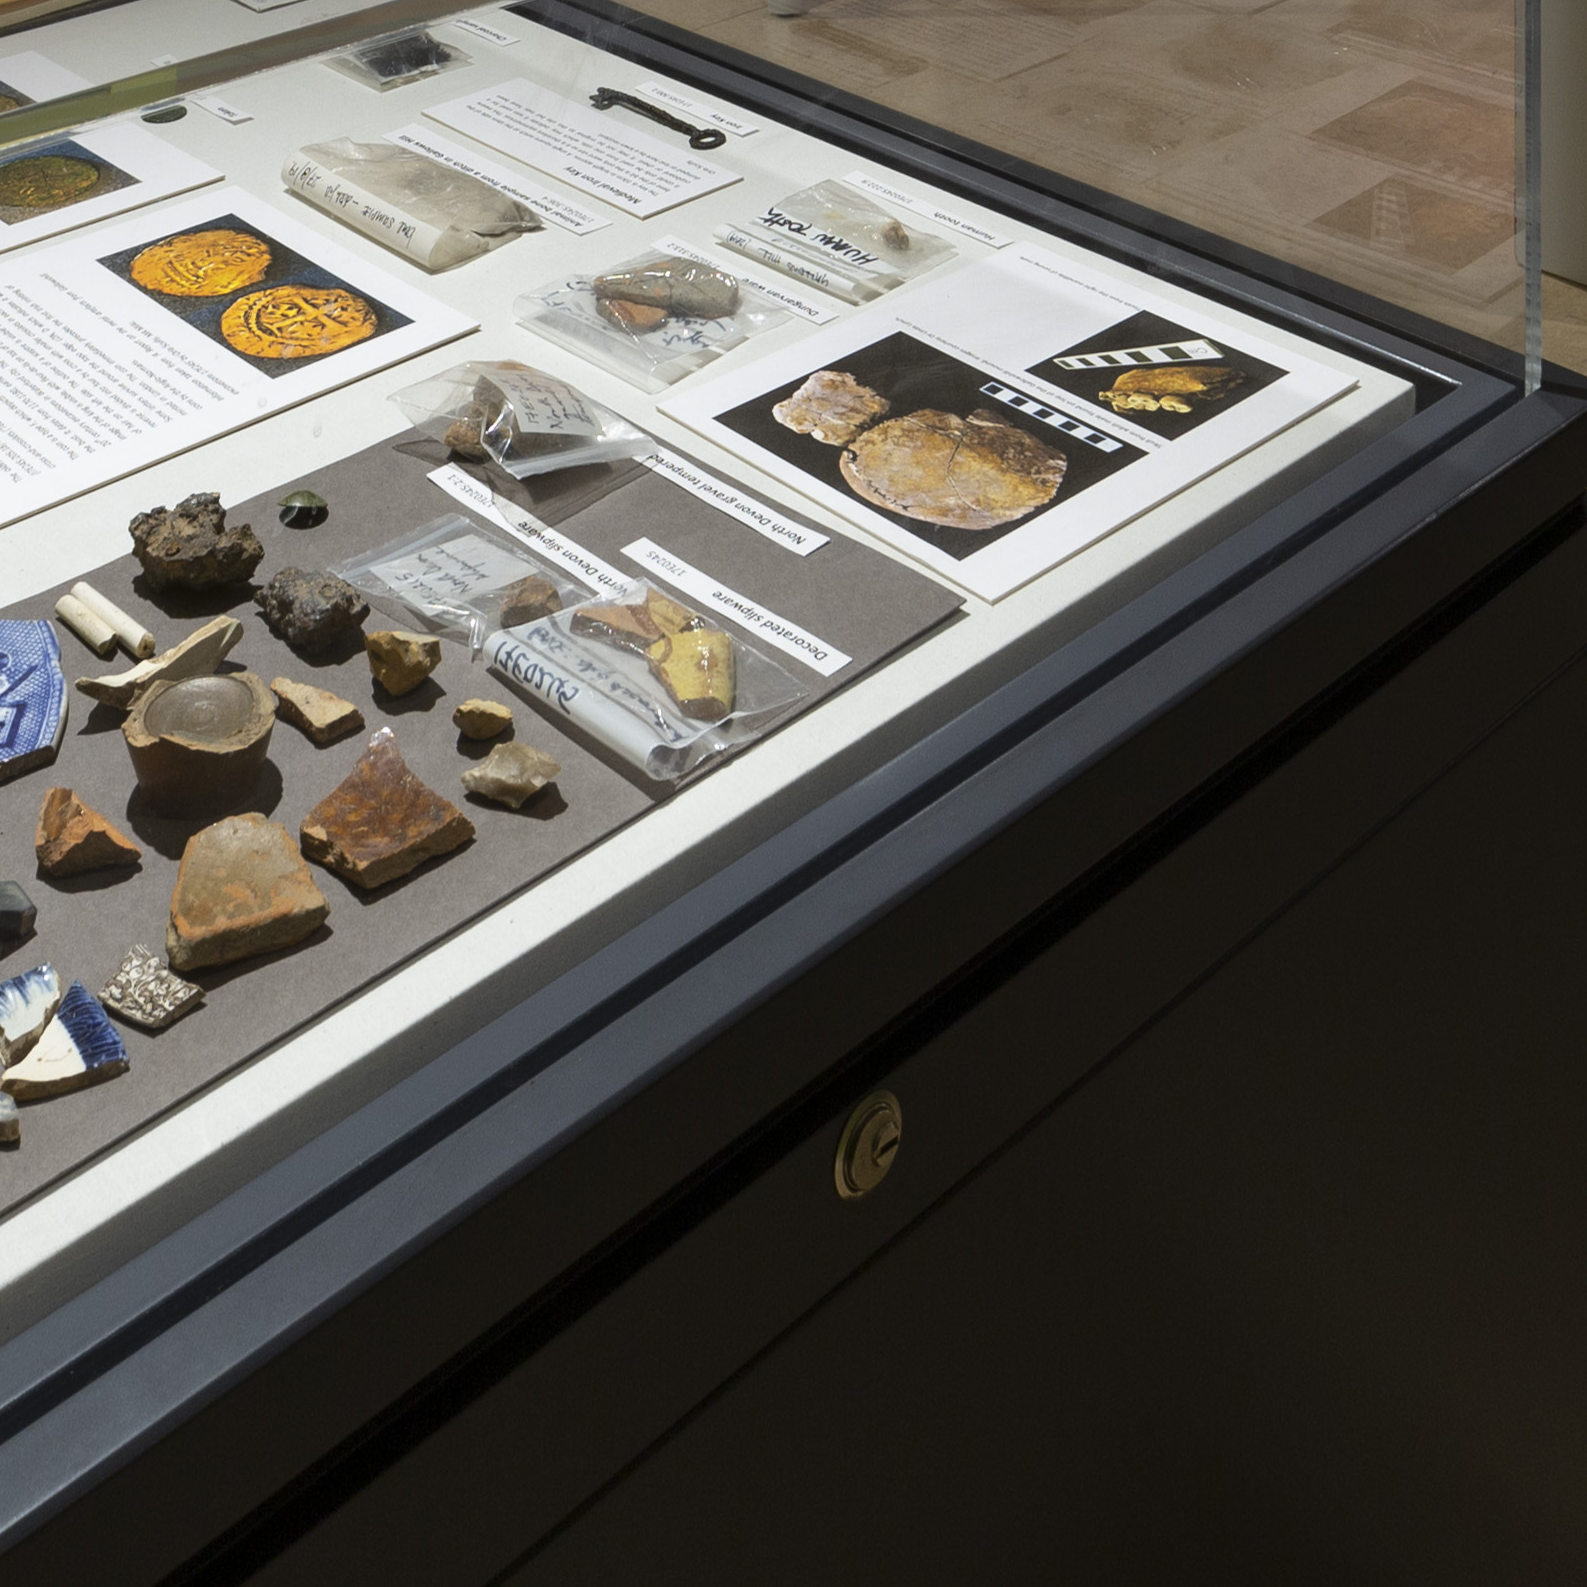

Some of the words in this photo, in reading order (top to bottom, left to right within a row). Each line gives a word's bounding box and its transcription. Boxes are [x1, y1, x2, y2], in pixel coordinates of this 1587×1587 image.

[398, 134, 415, 143] Hill
[413, 141, 444, 158] Gallows
[452, 160, 474, 172] ditch
[563, 166, 582, 176] Key
[479, 174, 501, 186] from
[580, 173, 601, 185] Iron
[499, 184, 531, 200] sample
[596, 182, 642, 204] Medieval
[529, 199, 553, 212] bone
[549, 210, 583, 226] Animal
[933, 211, 960, 225] tooth
[960, 223, 995, 240] Human
[741, 277, 766, 290] ware
[766, 289, 819, 316] Dungarvan
[644, 453, 701, 485] tempered
[696, 483, 737, 503] gravel
[734, 502, 771, 525] Devon
[512, 520, 563, 551] slipware
[771, 523, 806, 544] North
[561, 549, 598, 575] Devon
[646, 550, 685, 576] 17E0245
[711, 590, 764, 621] slipware
[758, 619, 828, 661] Decorated
